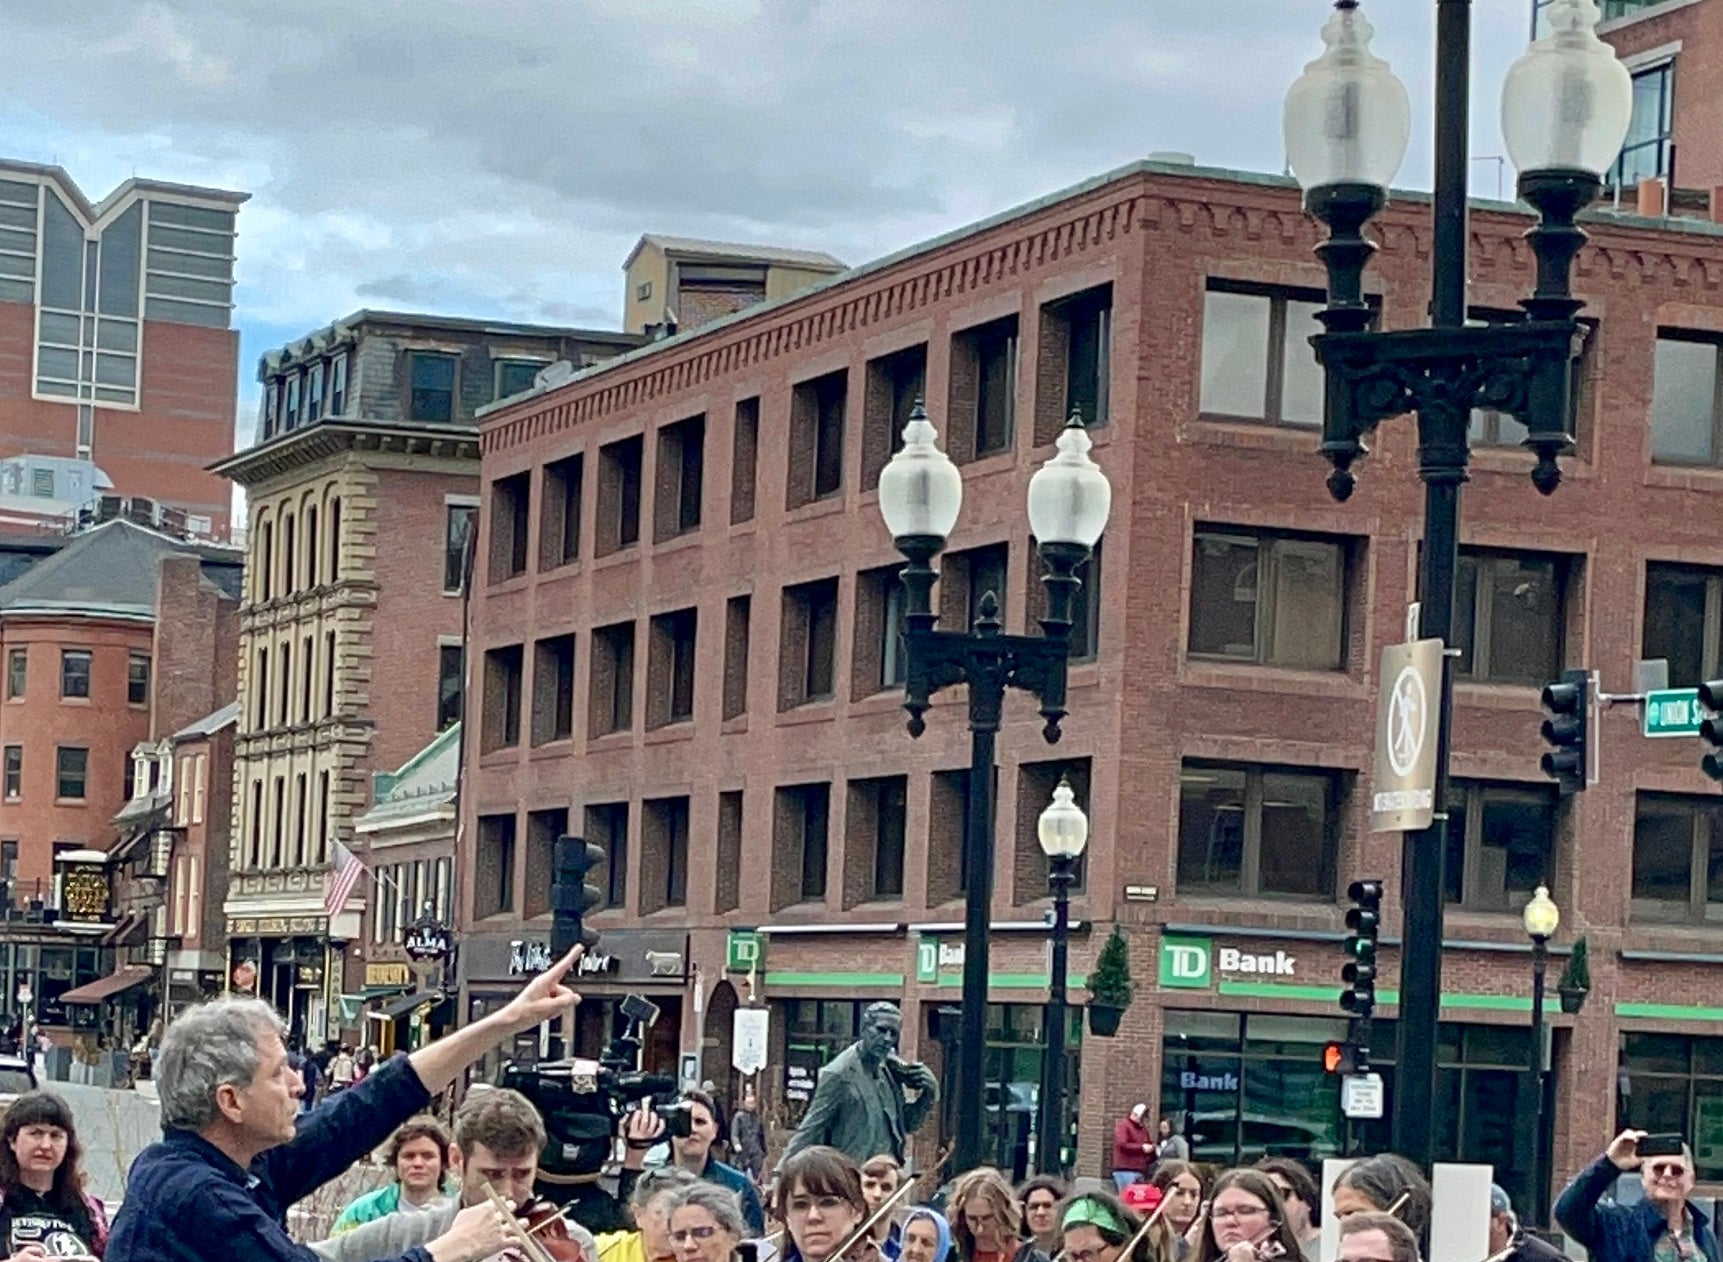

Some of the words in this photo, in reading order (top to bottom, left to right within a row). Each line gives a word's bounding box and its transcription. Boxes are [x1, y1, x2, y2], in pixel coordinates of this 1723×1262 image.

[406, 936, 446, 950] ALMA
[733, 940, 759, 961] TD
[919, 944, 936, 973] TD
[1164, 945, 1207, 978] TD
[1219, 948, 1296, 975] Bank
[1180, 1071, 1238, 1091] Bank
